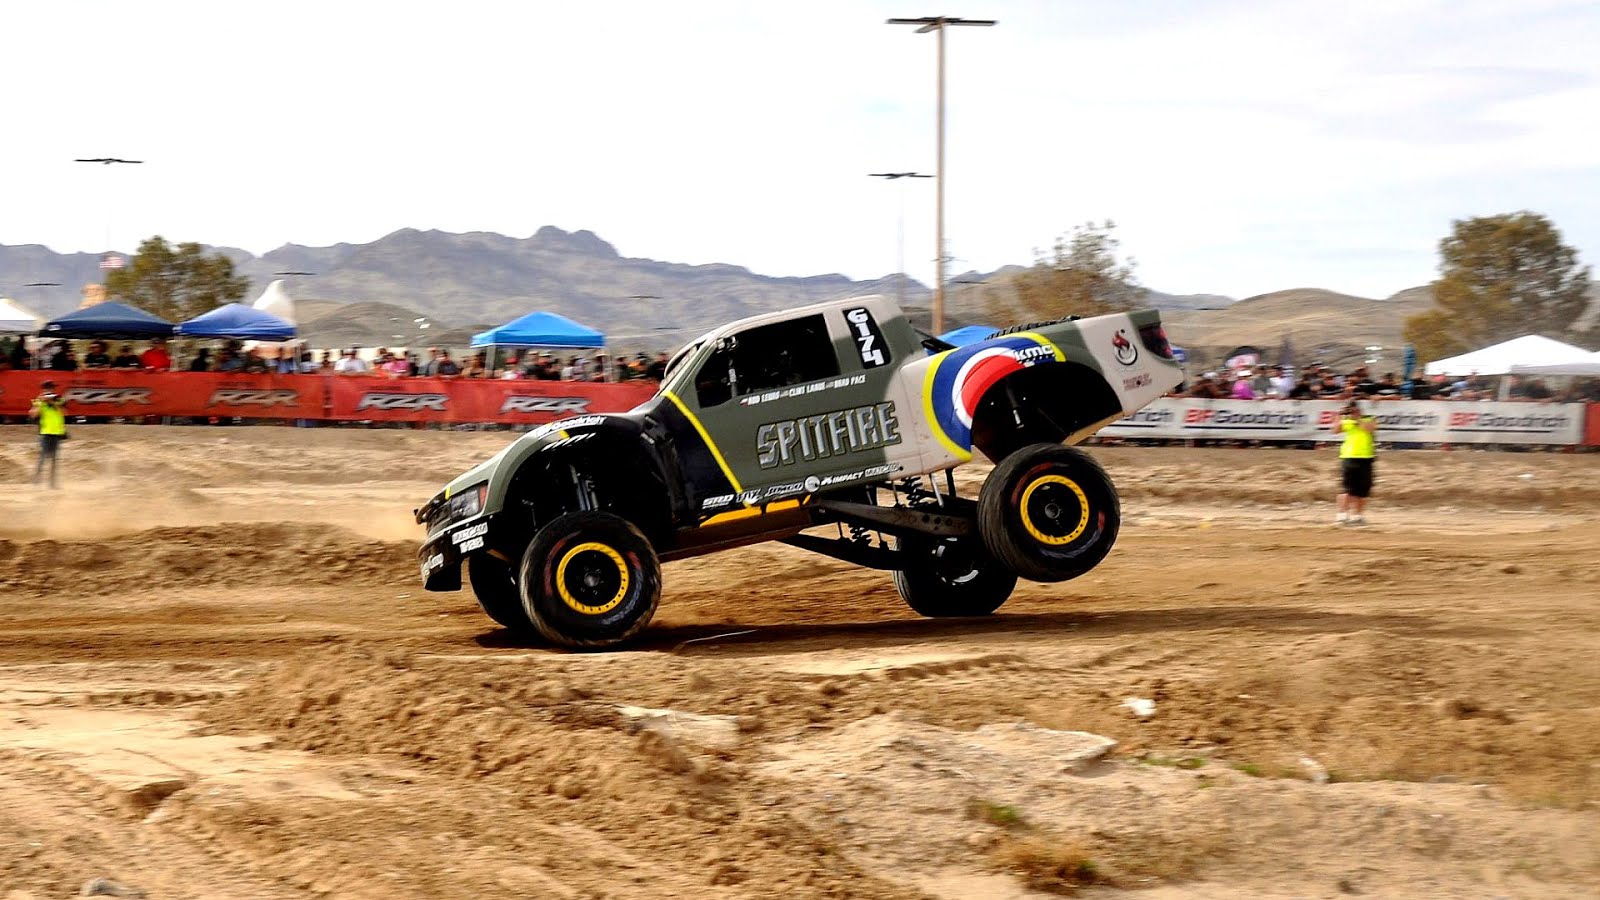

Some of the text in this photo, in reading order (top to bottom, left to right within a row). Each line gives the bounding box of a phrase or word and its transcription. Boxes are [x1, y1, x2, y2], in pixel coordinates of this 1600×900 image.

[847, 308, 885, 366] 6174
[207, 388, 300, 408] RZR
[356, 392, 449, 412] RZR
[501, 395, 593, 414] RZR
[1184, 408, 1308, 424] BFGoodrich
[1449, 411, 1569, 428] BFGoodrich
[756, 400, 902, 470] SPITFIRE
